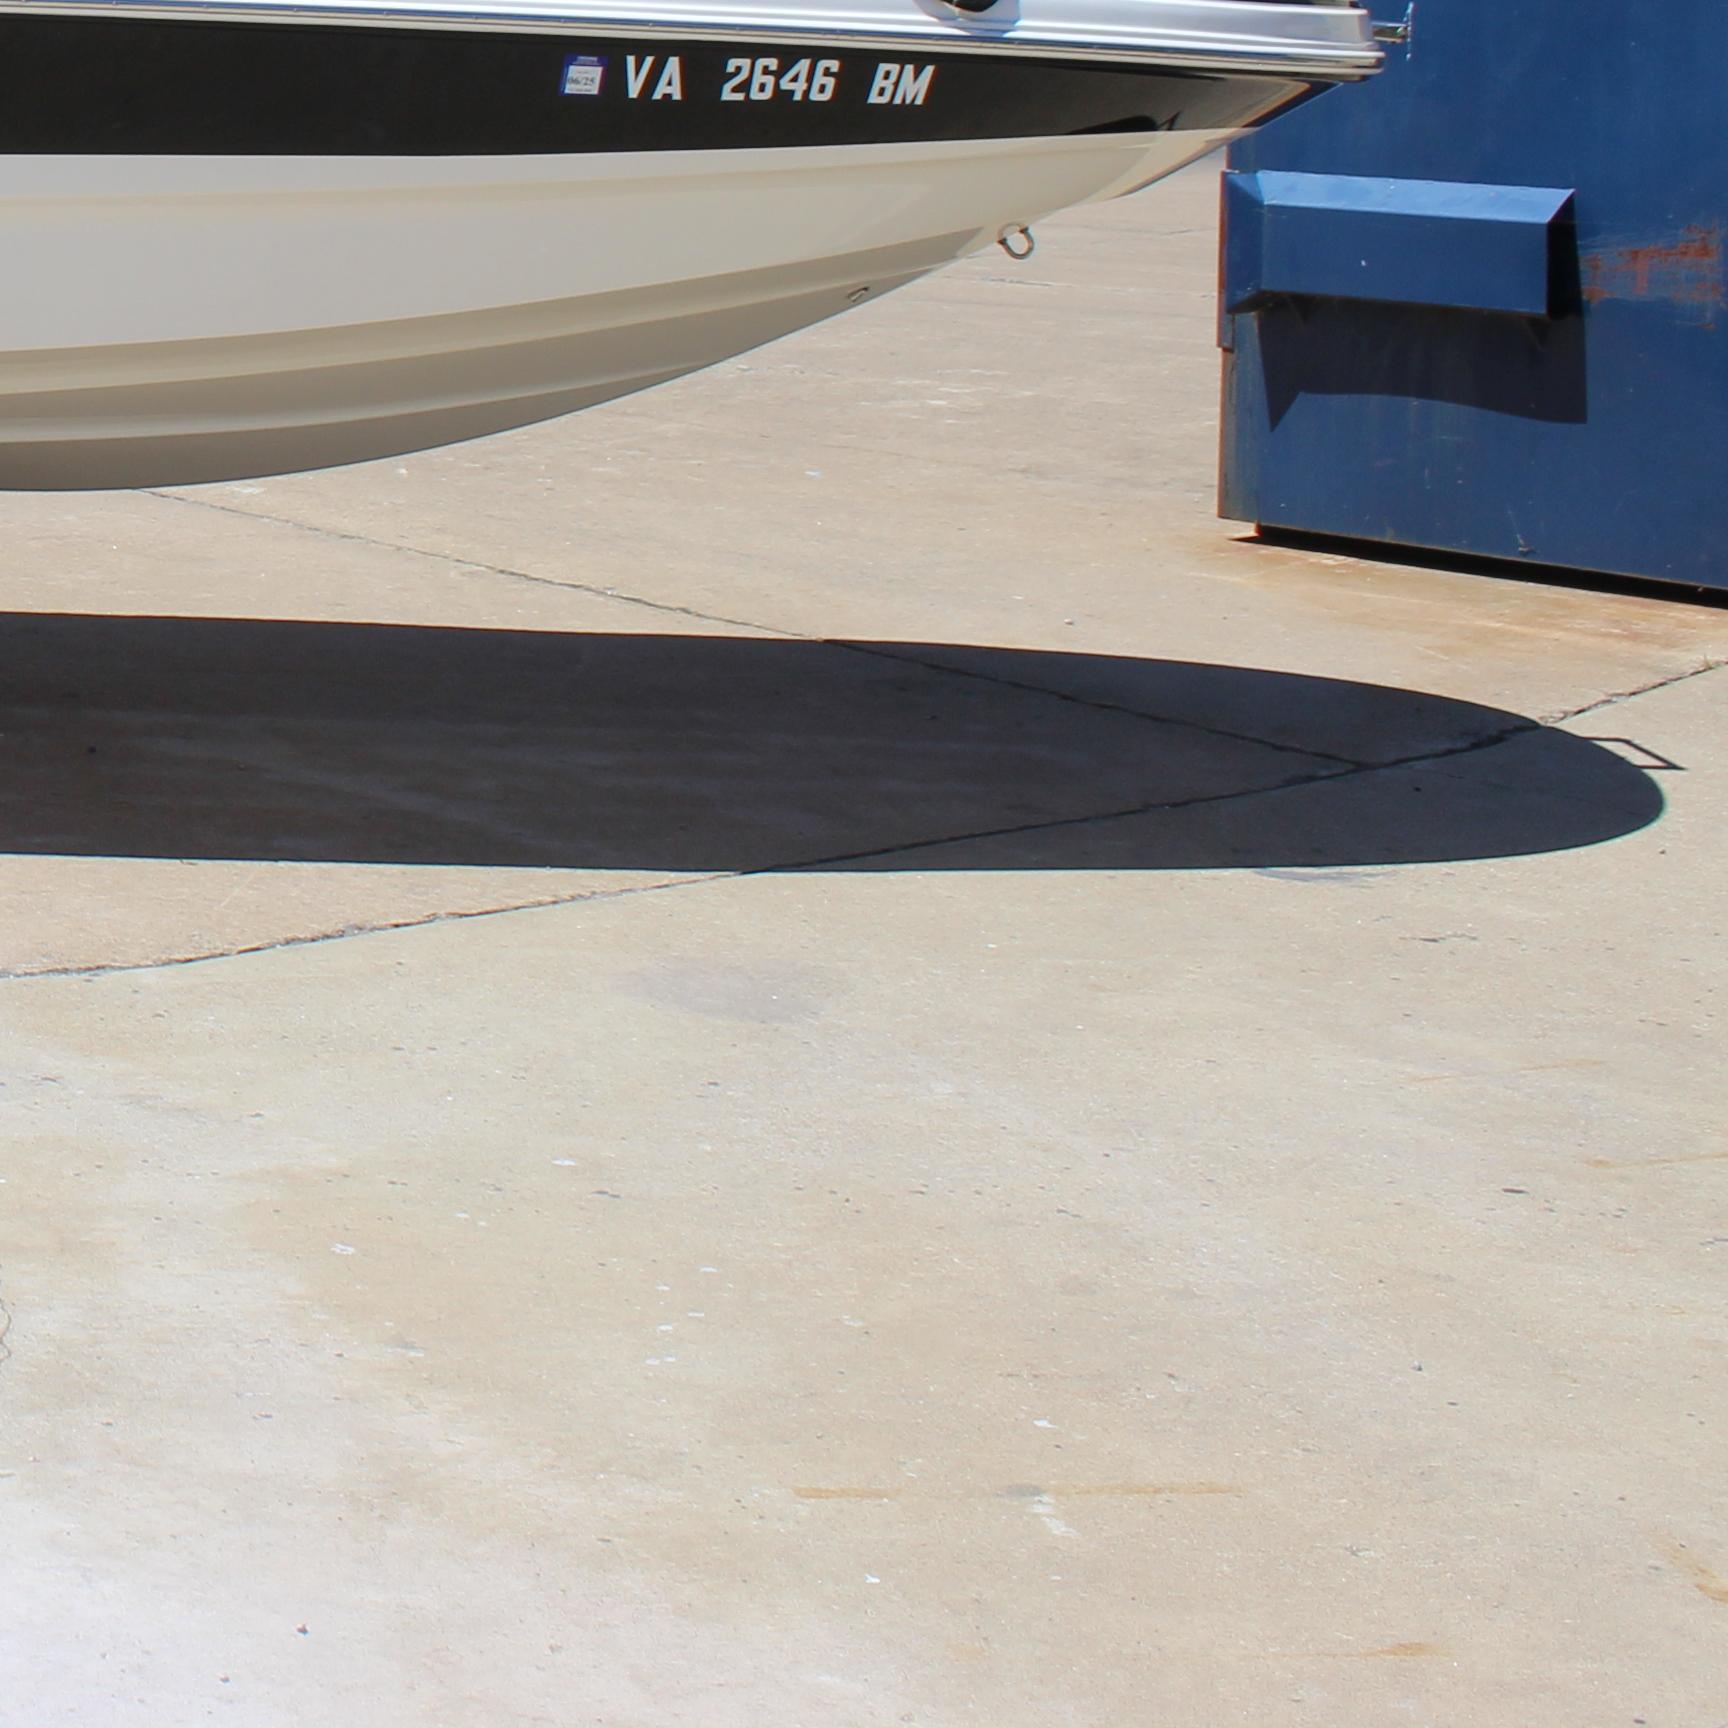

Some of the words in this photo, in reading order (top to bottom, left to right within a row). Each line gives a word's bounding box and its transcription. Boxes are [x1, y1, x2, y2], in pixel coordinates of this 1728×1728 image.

[626, 55, 682, 100] VA
[720, 57, 840, 102] 2646
[866, 63, 935, 105] BM
